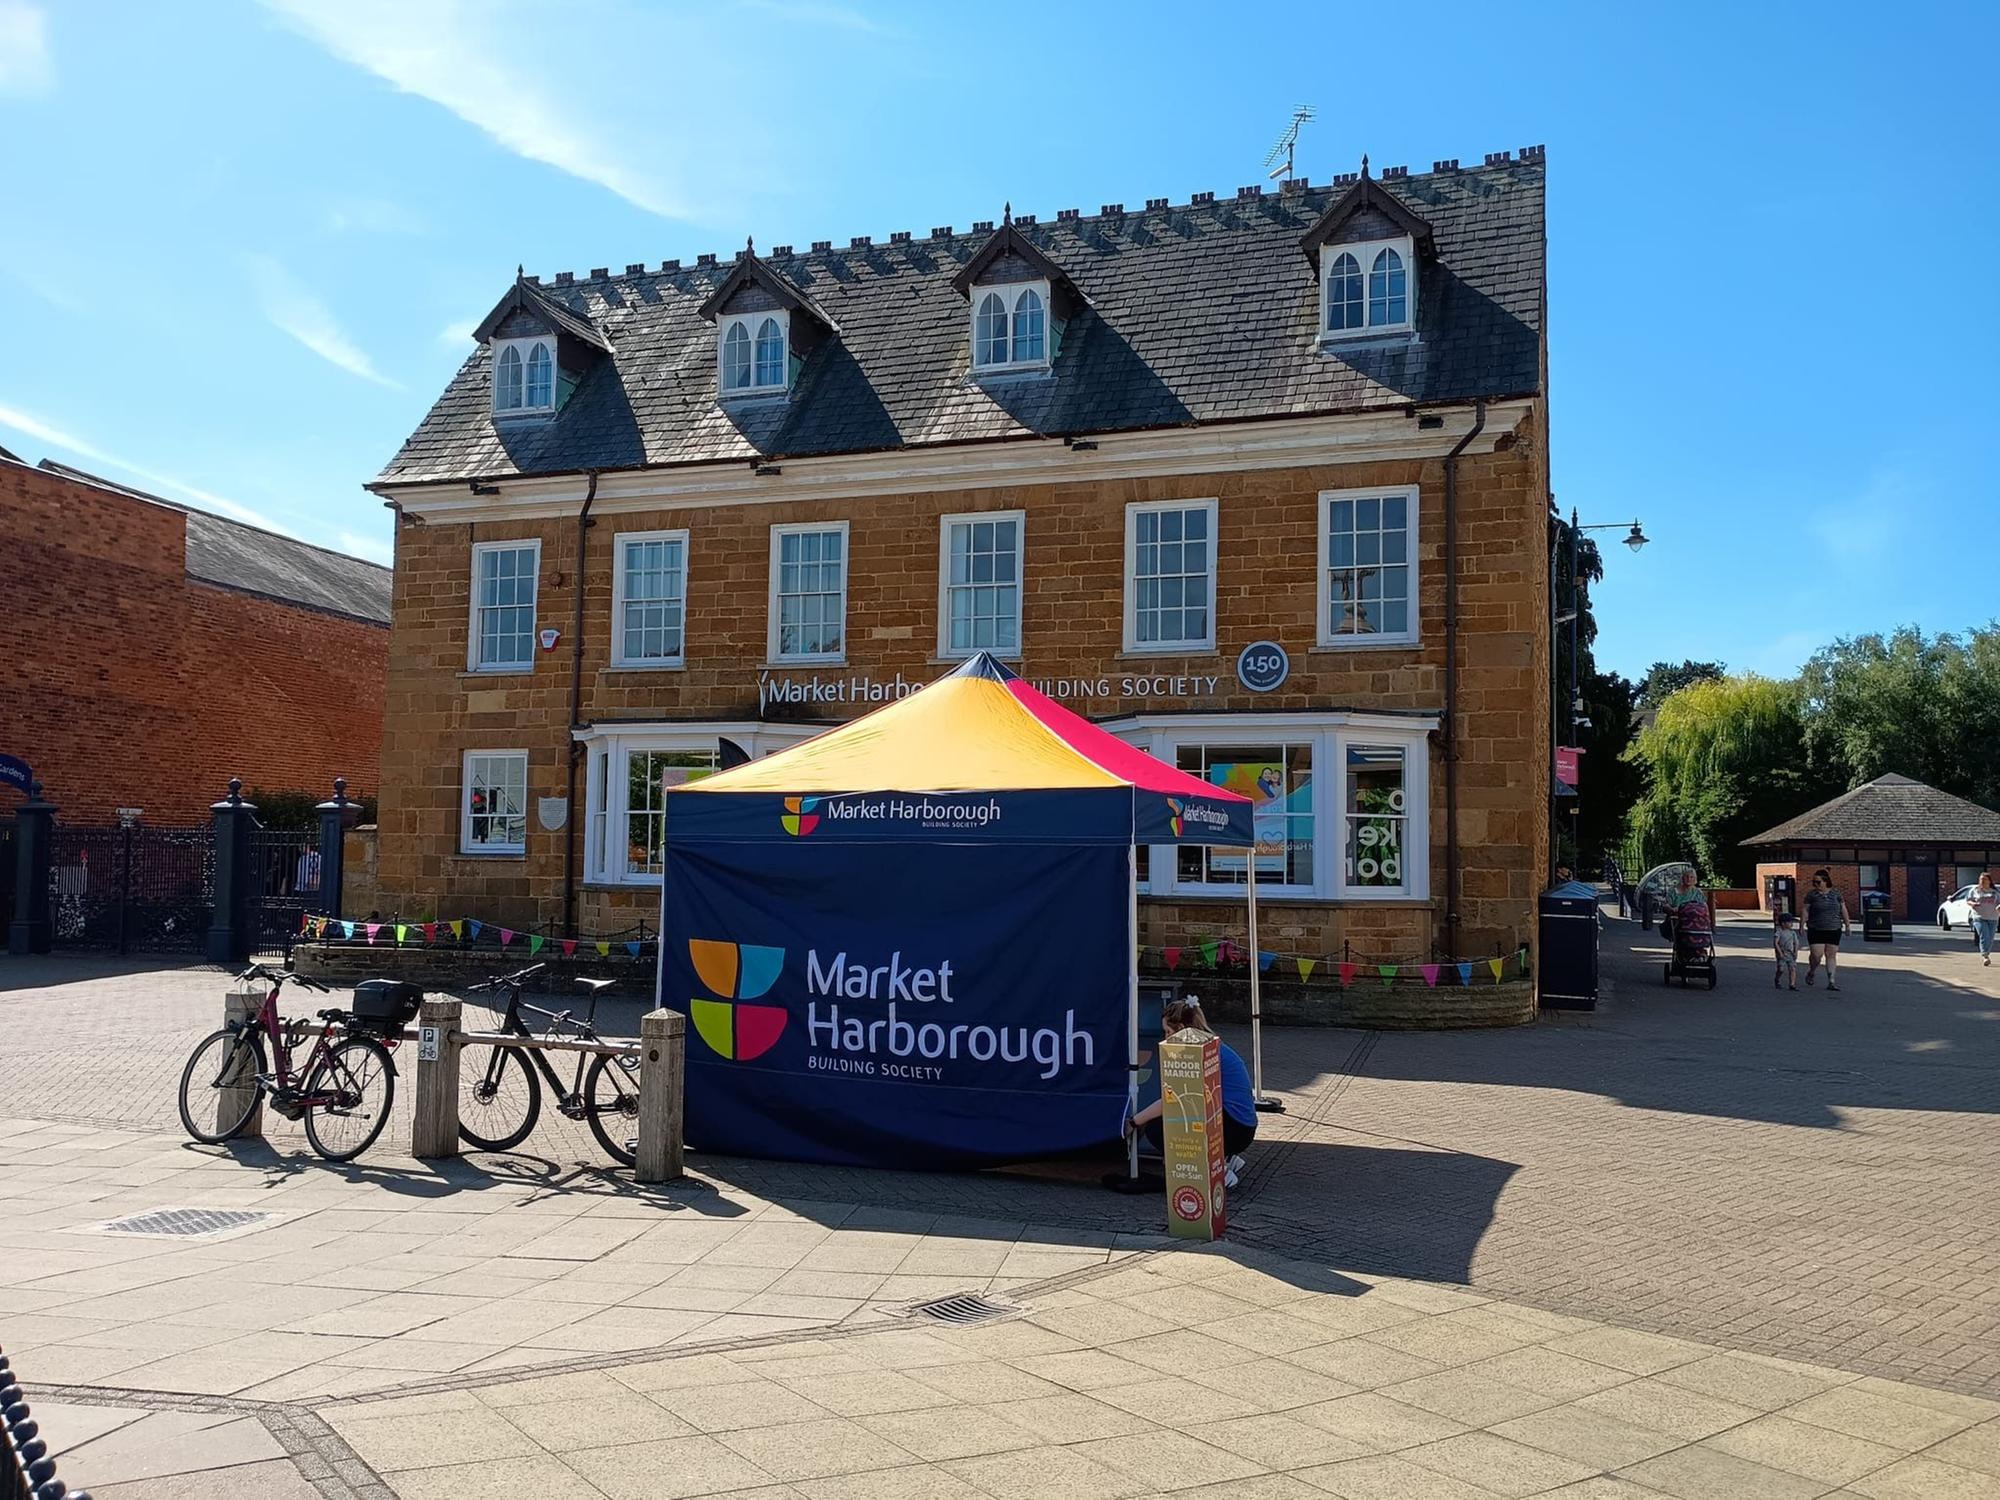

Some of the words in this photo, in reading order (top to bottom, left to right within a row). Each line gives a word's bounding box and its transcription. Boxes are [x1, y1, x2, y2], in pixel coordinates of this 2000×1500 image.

[1246, 655, 1281, 673] 150
[769, 676, 846, 703] Market
[851, 672, 925, 701] Harbo
[1032, 679, 1110, 698] UILDING
[1121, 676, 1218, 696] SOCIETY
[828, 800, 886, 819] Market
[890, 798, 1000, 826] Harborough
[807, 949, 954, 1003] Market
[807, 1002, 1094, 1079] Harborough
[808, 1055, 875, 1075] BUILDING
[881, 1063, 943, 1080] SOCIETY
[1163, 1060, 1201, 1070] INDOOR
[1164, 1069, 1201, 1079] MARKET
[1175, 1163, 1198, 1172] OPEN
